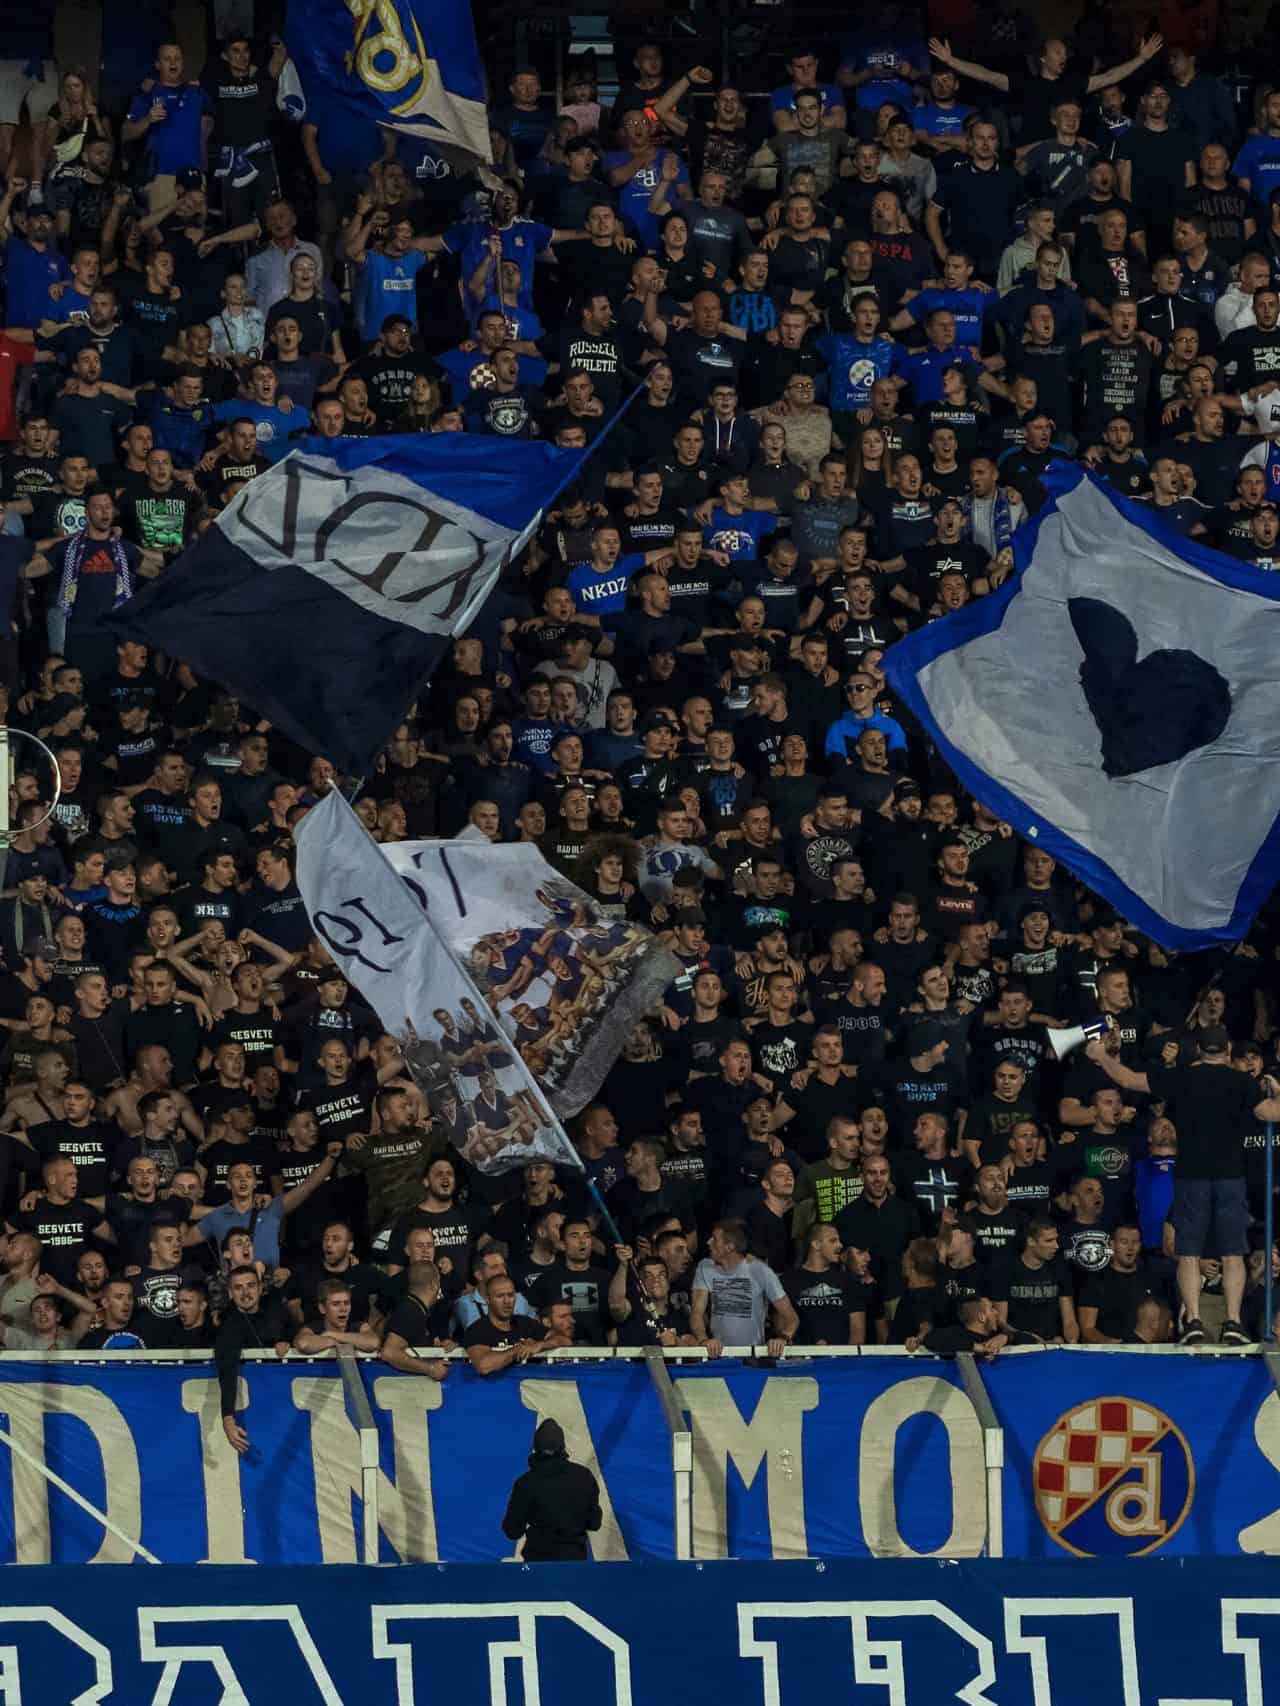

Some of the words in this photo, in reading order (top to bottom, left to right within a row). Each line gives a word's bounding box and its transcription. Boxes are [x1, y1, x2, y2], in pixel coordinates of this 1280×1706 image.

[570, 341, 618, 360] RUSSELL
[571, 357, 617, 373] ATHLETIC
[581, 576, 627, 602] NKDZ
[315, 1094, 361, 1114] SESVETE
[59, 1142, 104, 1153] SESVETE
[38, 1223, 84, 1234] SESVETE
[0, 1375, 989, 1566] DINAMO
